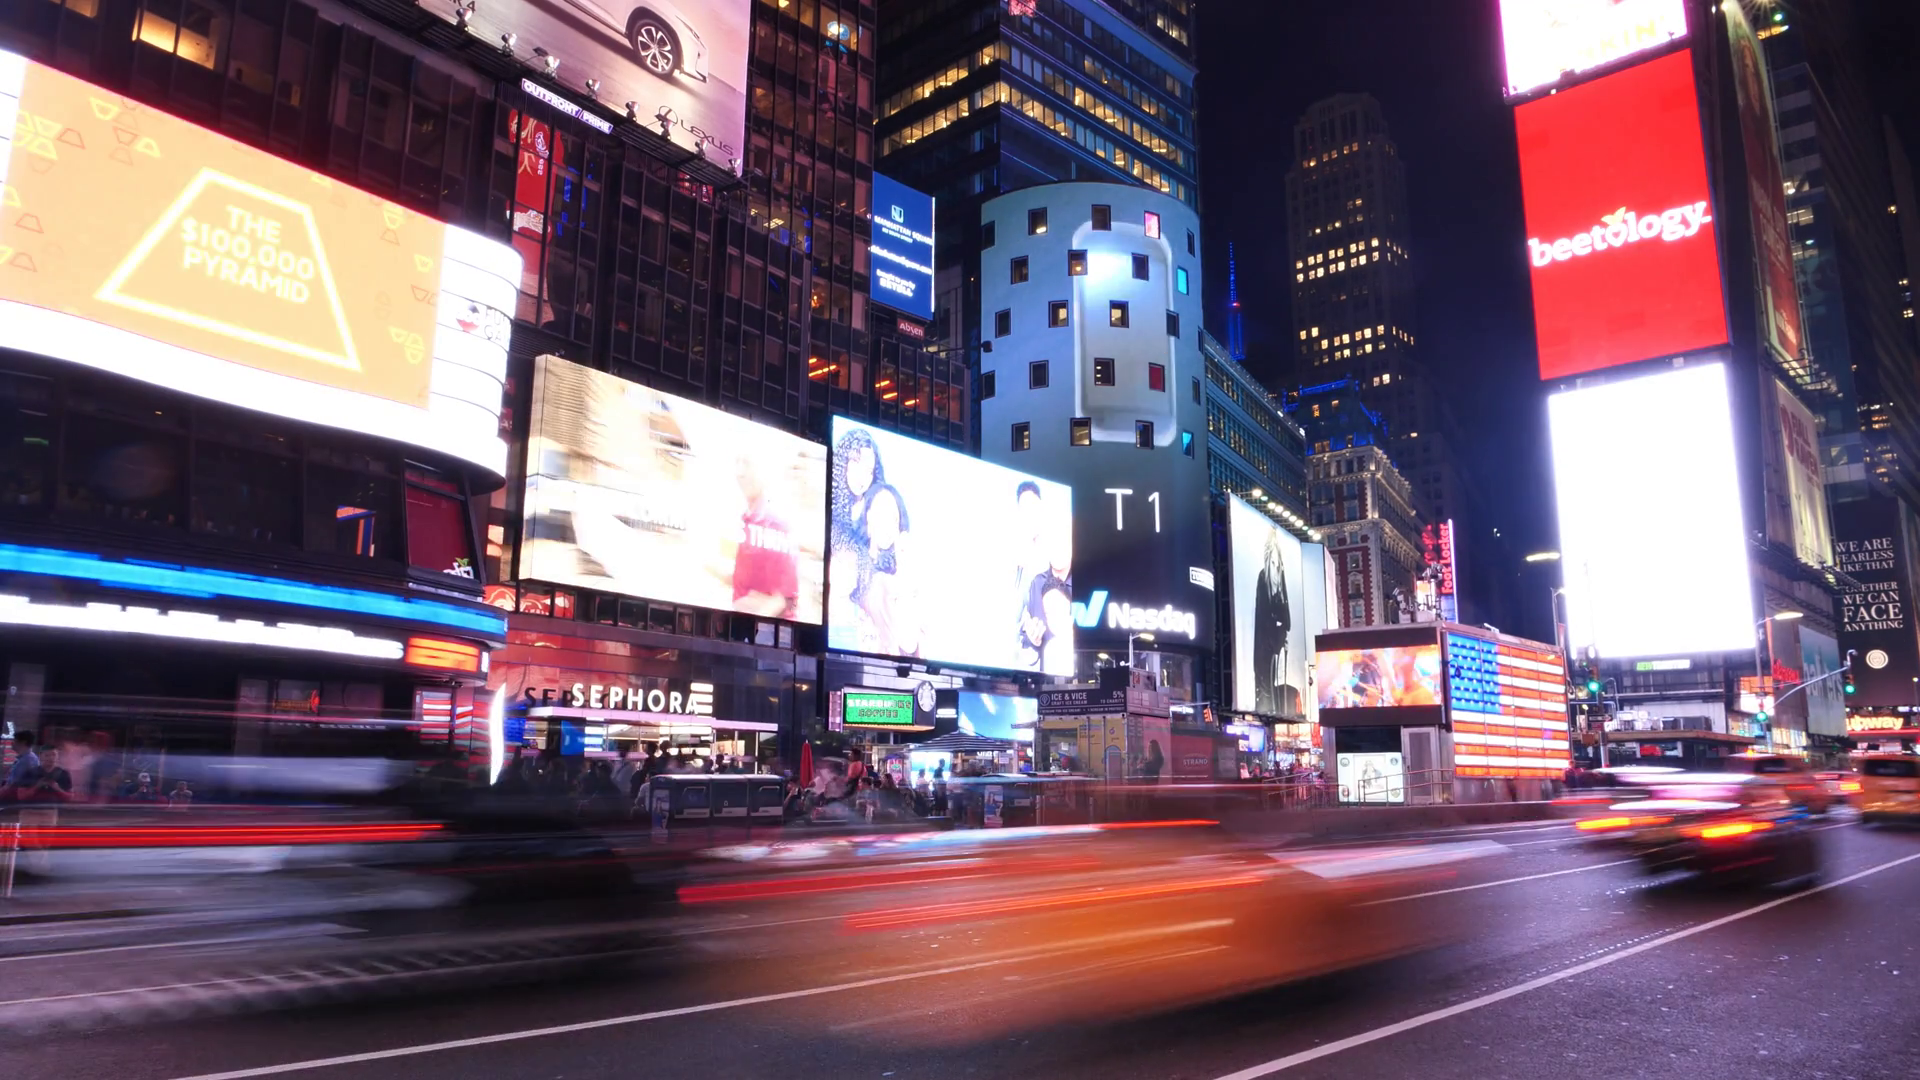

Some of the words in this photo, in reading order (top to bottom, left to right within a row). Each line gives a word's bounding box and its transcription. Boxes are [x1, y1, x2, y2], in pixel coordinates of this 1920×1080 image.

[524, 82, 578, 116] OUTFRONT
[583, 113, 611, 133] PRIME
[681, 119, 733, 156] LEXUS
[226, 204, 282, 244] THE
[183, 246, 310, 304] PYRAMID
[1438, 523, 1451, 564] Locker
[1835, 541, 1859, 553] WE
[1862, 537, 1893, 551] ARE
[1842, 562, 1863, 572] IKE
[1864, 560, 1895, 571] THAT
[1841, 581, 1898, 593] TOETHER
[1842, 593, 1866, 605] WE
[1868, 591, 1899, 603] CAN
[1842, 603, 1903, 622] FACE
[1107, 602, 1196, 640] Nasdaq
[1844, 620, 1904, 632] ANYTHING
[571, 682, 701, 715] SEPHORA
[1051, 693, 1062, 701] ICE
[1071, 691, 1088, 700] VICE
[1112, 690, 1124, 699] 5%
[858, 709, 899, 718] COFFEE
[1846, 715, 1904, 731] ubway
[1182, 757, 1209, 766] STRAND
